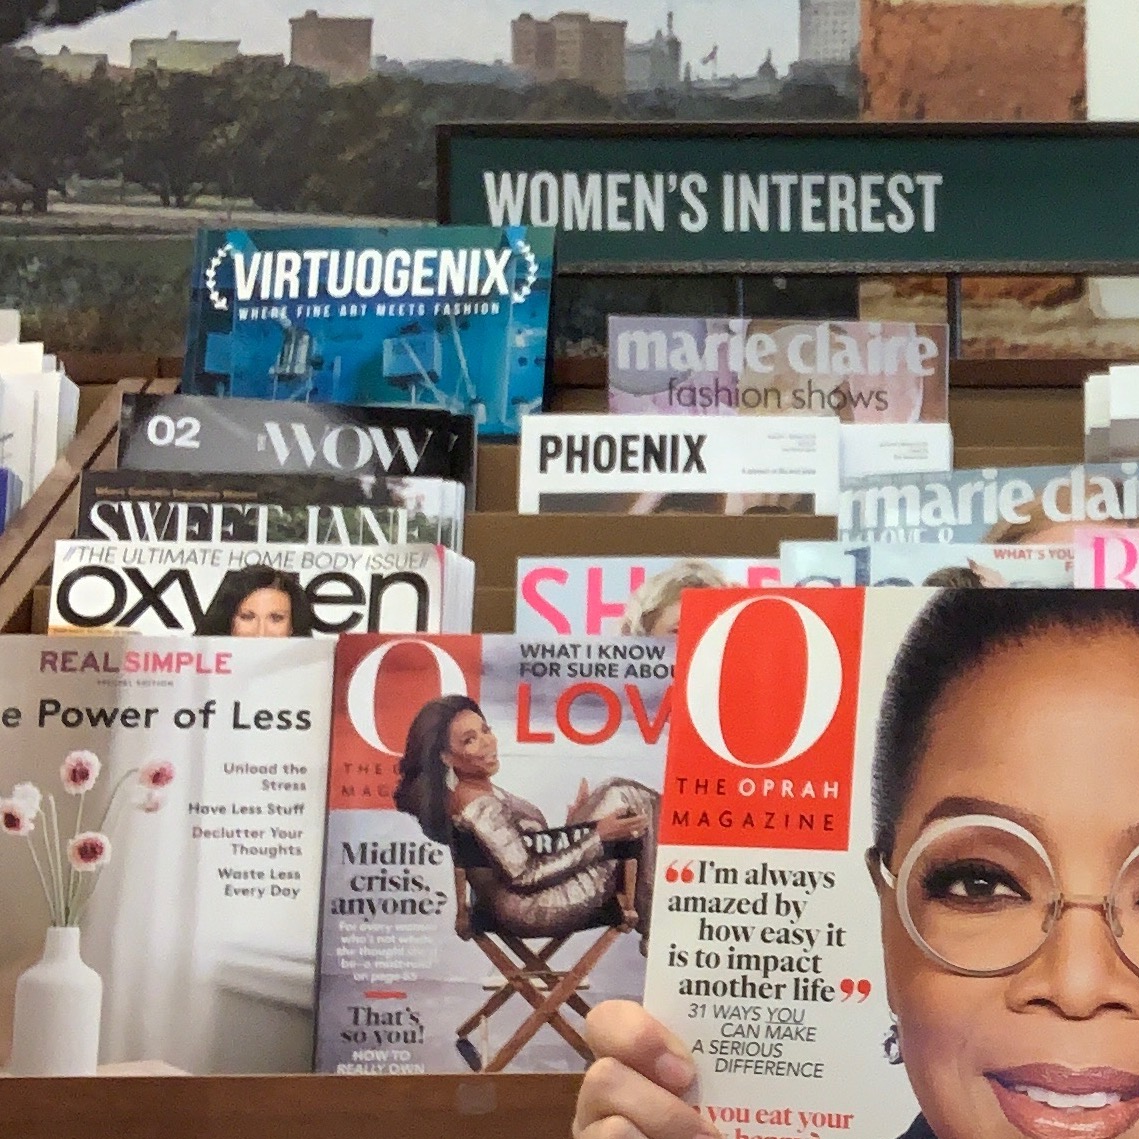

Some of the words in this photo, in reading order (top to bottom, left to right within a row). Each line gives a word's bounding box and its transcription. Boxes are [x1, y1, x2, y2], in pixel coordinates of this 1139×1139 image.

[484, 171, 709, 233] WOMEN'S
[722, 173, 943, 233] INTEREST
[233, 249, 512, 301] VIRTUOGENIX
[297, 305, 330, 318] FINE
[340, 304, 367, 317] ART
[376, 303, 425, 317] MEETS
[434, 302, 500, 316] FASHION
[617, 319, 778, 373] marie
[788, 322, 939, 376] claire
[668, 377, 781, 409] fashion
[791, 378, 889, 411] shows
[147, 415, 201, 449] 02
[264, 421, 434, 473] WOW
[539, 434, 708, 474] PHOENIX
[865, 467, 1035, 528] marie
[123, 547, 222, 567] ULTIMATE
[229, 549, 294, 569] HOME
[302, 551, 363, 571] BODY
[520, 643, 581, 659] WHAT
[599, 644, 666, 660] KNOW
[520, 662, 561, 677] FOR
[567, 662, 619, 678] SURE
[686, 595, 843, 769] O
[38, 699, 159, 729] Power
[174, 700, 216, 729] of
[232, 701, 312, 731] Less
[517, 682, 673, 745] LOV
[223, 763, 278, 775] Unload
[283, 763, 308, 775] the
[261, 779, 307, 791] Stress
[676, 777, 727, 795] THE
[738, 778, 840, 799] OPRAH
[188, 803, 227, 815] Have
[232, 803, 263, 815] Less
[267, 802, 305, 815] Stuff
[672, 810, 835, 832] MAGAZINE
[192, 827, 265, 839] Declutter
[271, 828, 303, 840] Your
[231, 844, 303, 859] Thoughts
[342, 841, 444, 866] Midlife
[218, 868, 265, 880] Waste
[270, 869, 301, 880] Less
[745, 862, 836, 895] always
[225, 885, 265, 898] Every
[271, 886, 301, 899] Day
[331, 891, 448, 922] anyone?
[668, 893, 768, 914] amazed
[775, 892, 808, 924] by
[699, 918, 755, 942] how
[760, 927, 821, 953] easy
[825, 922, 848, 947] it
[667, 943, 689, 967] is
[695, 948, 720, 969] to
[727, 946, 823, 978] impact
[679, 975, 787, 1000] another
[347, 1006, 420, 1027] That's
[687, 1003, 707, 1019] 31
[713, 1004, 761, 1021] WAYS
[766, 1007, 806, 1023] YOU
[340, 1031, 367, 1043] so
[374, 1026, 425, 1049] you!
[720, 1023, 760, 1039] CAN
[765, 1025, 818, 1042] MAKE
[691, 1039, 705, 1054] A
[708, 1039, 784, 1058] SERIOUS
[714, 1058, 825, 1078] DIFFERENCE
[755, 1108, 793, 1125] eat
[797, 1111, 855, 1133] your
